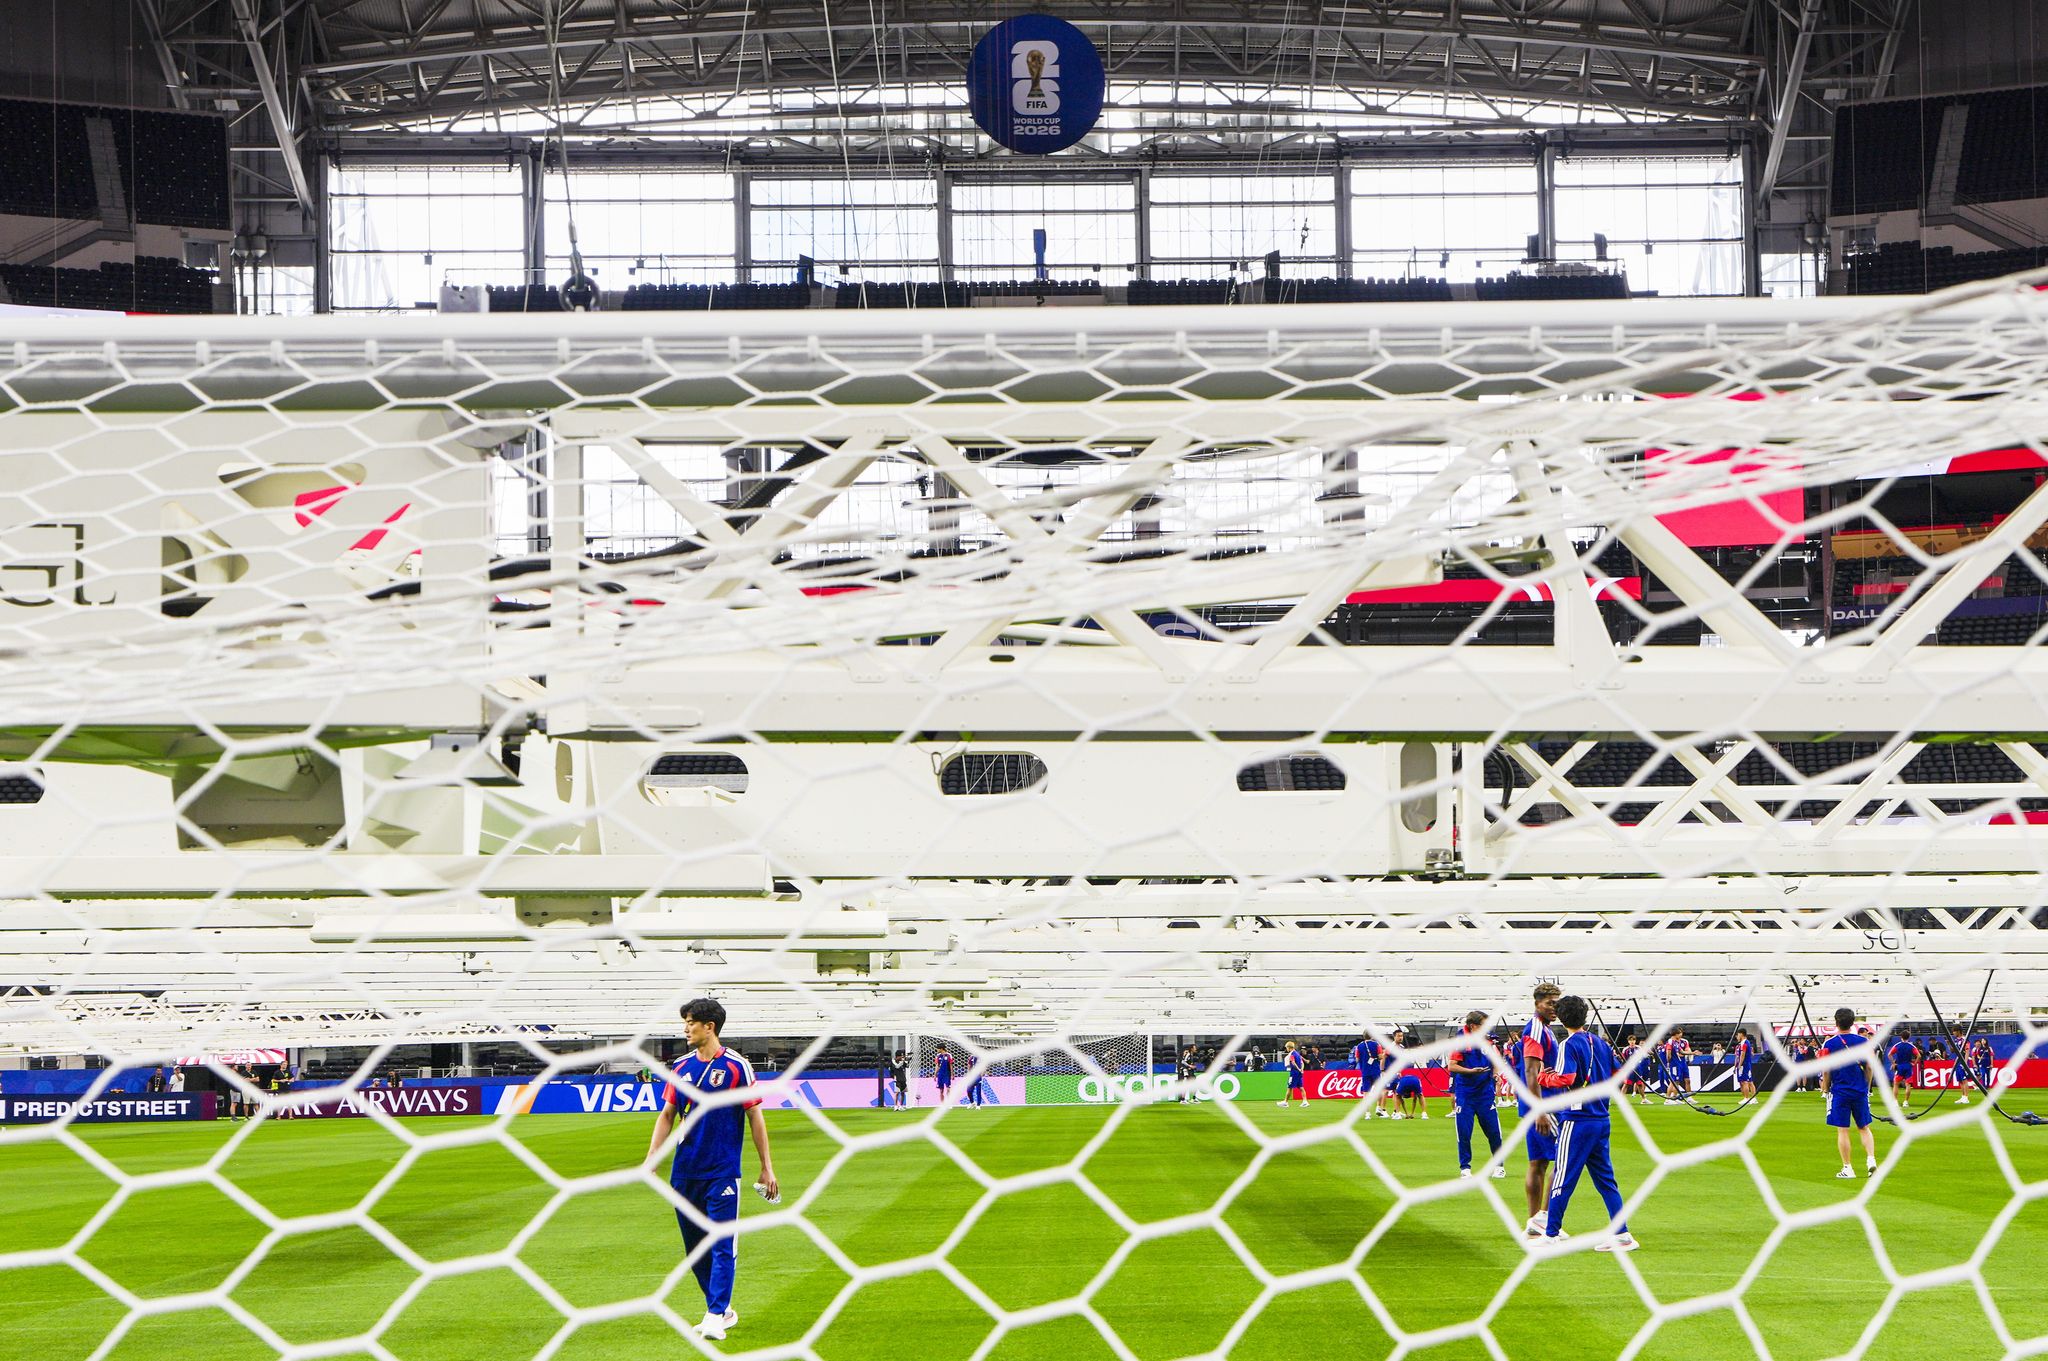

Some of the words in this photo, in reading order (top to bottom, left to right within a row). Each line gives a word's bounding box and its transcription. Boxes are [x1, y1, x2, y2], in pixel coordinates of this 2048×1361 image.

[1026, 101, 1048, 109] FIFA
[1013, 117, 1043, 125] WORLD
[1043, 117, 1061, 125] CUP
[1013, 125, 1061, 136] 2026
[1832, 607, 1908, 621] DALLS
[1916, 1062, 2018, 1087] lenvo
[336, 1087, 469, 1115] AIRWAYS
[571, 1083, 658, 1112] VISA
